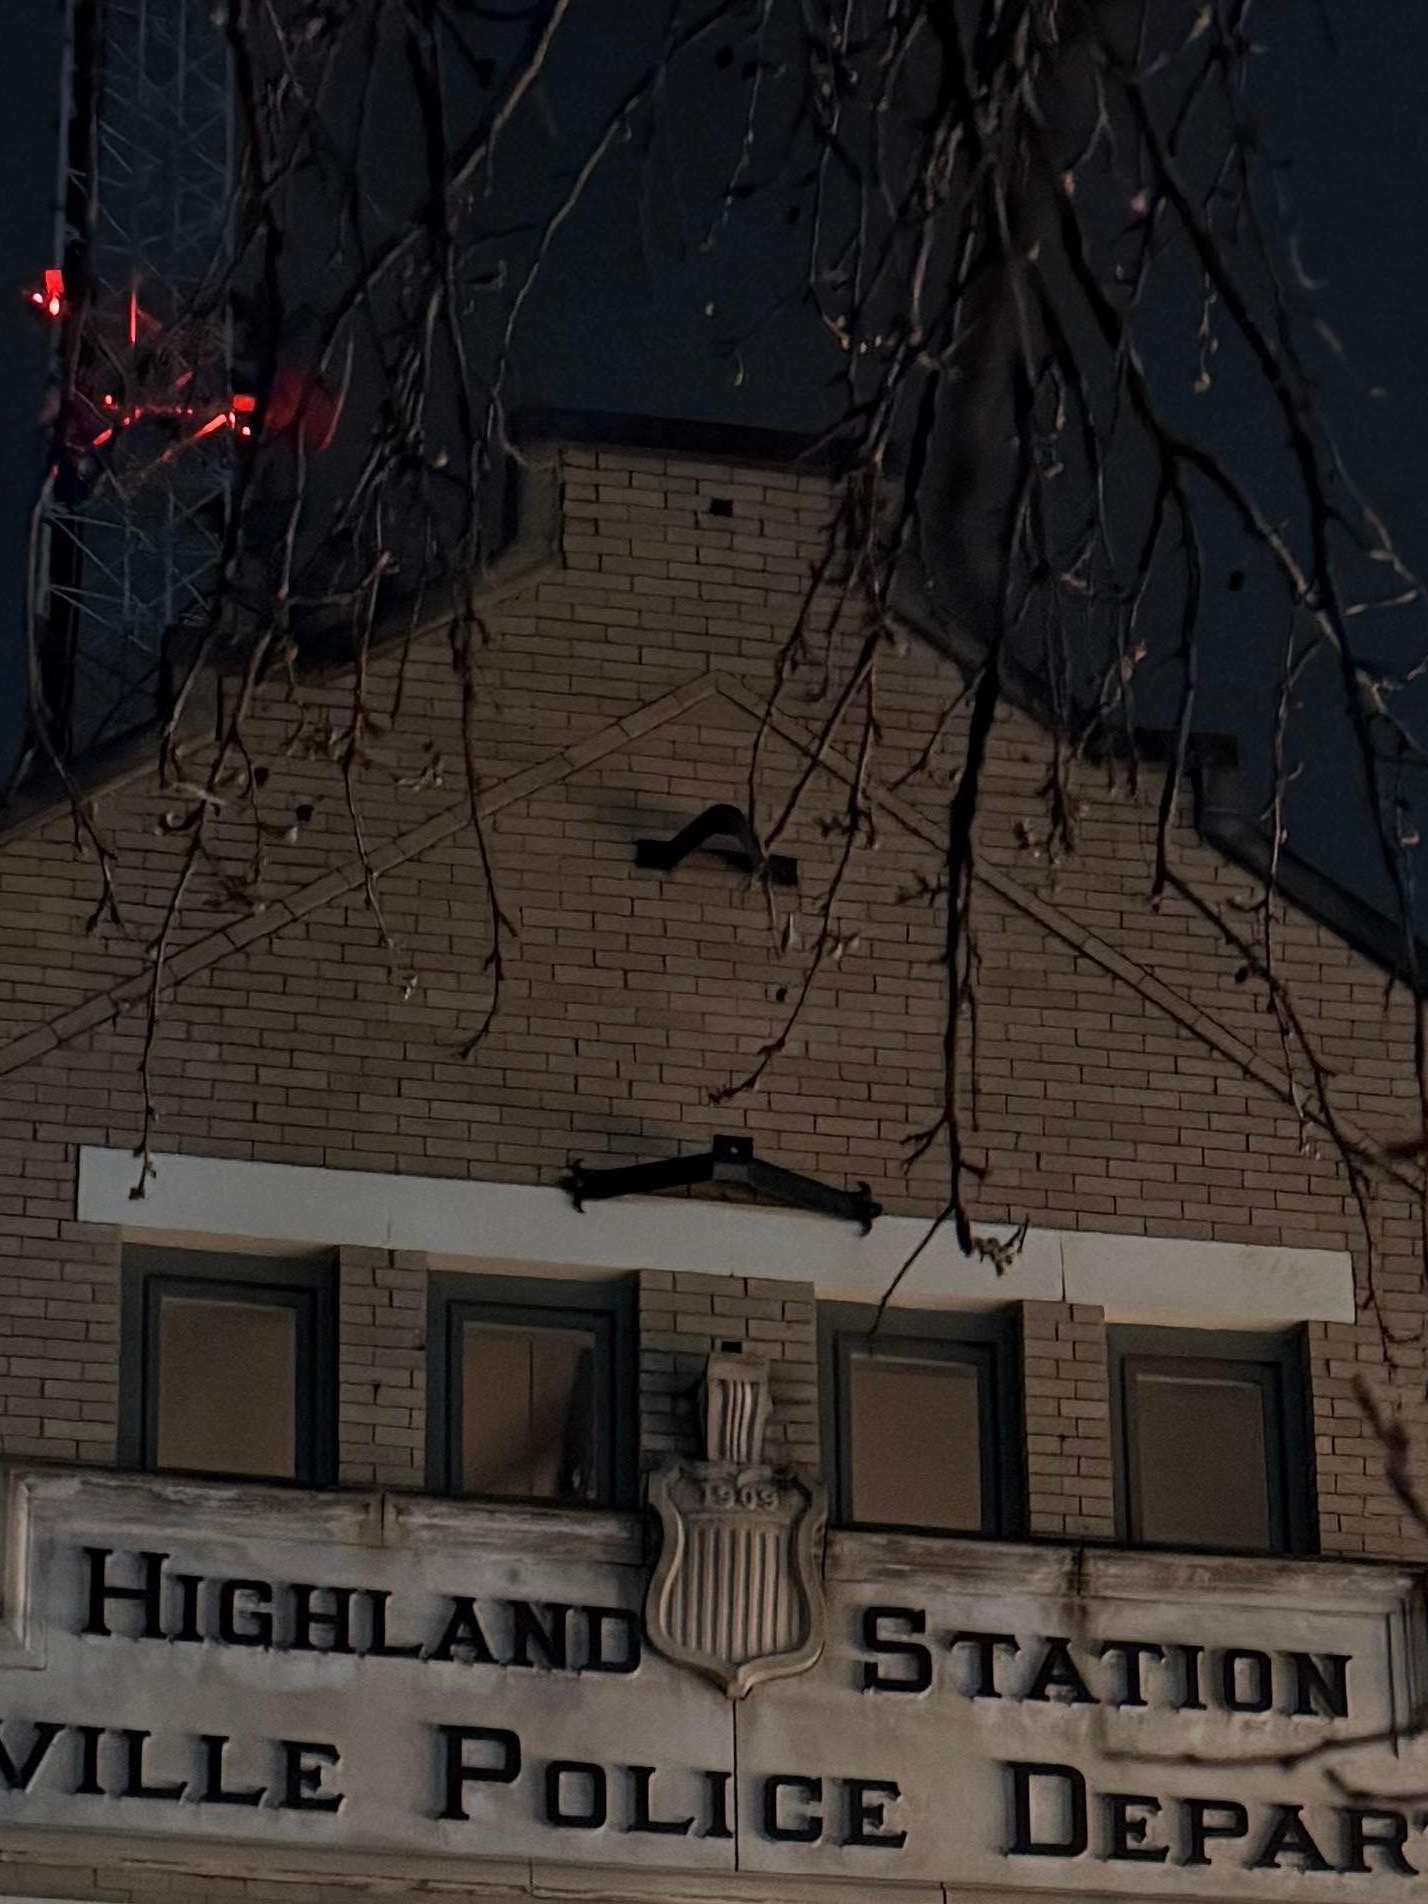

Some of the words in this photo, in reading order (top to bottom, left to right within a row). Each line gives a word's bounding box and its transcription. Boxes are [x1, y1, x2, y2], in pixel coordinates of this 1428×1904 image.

[82, 1546, 641, 1675] HIGHLAND
[862, 1605, 1354, 1718] STATION
[436, 1725, 910, 1849] POLICE
